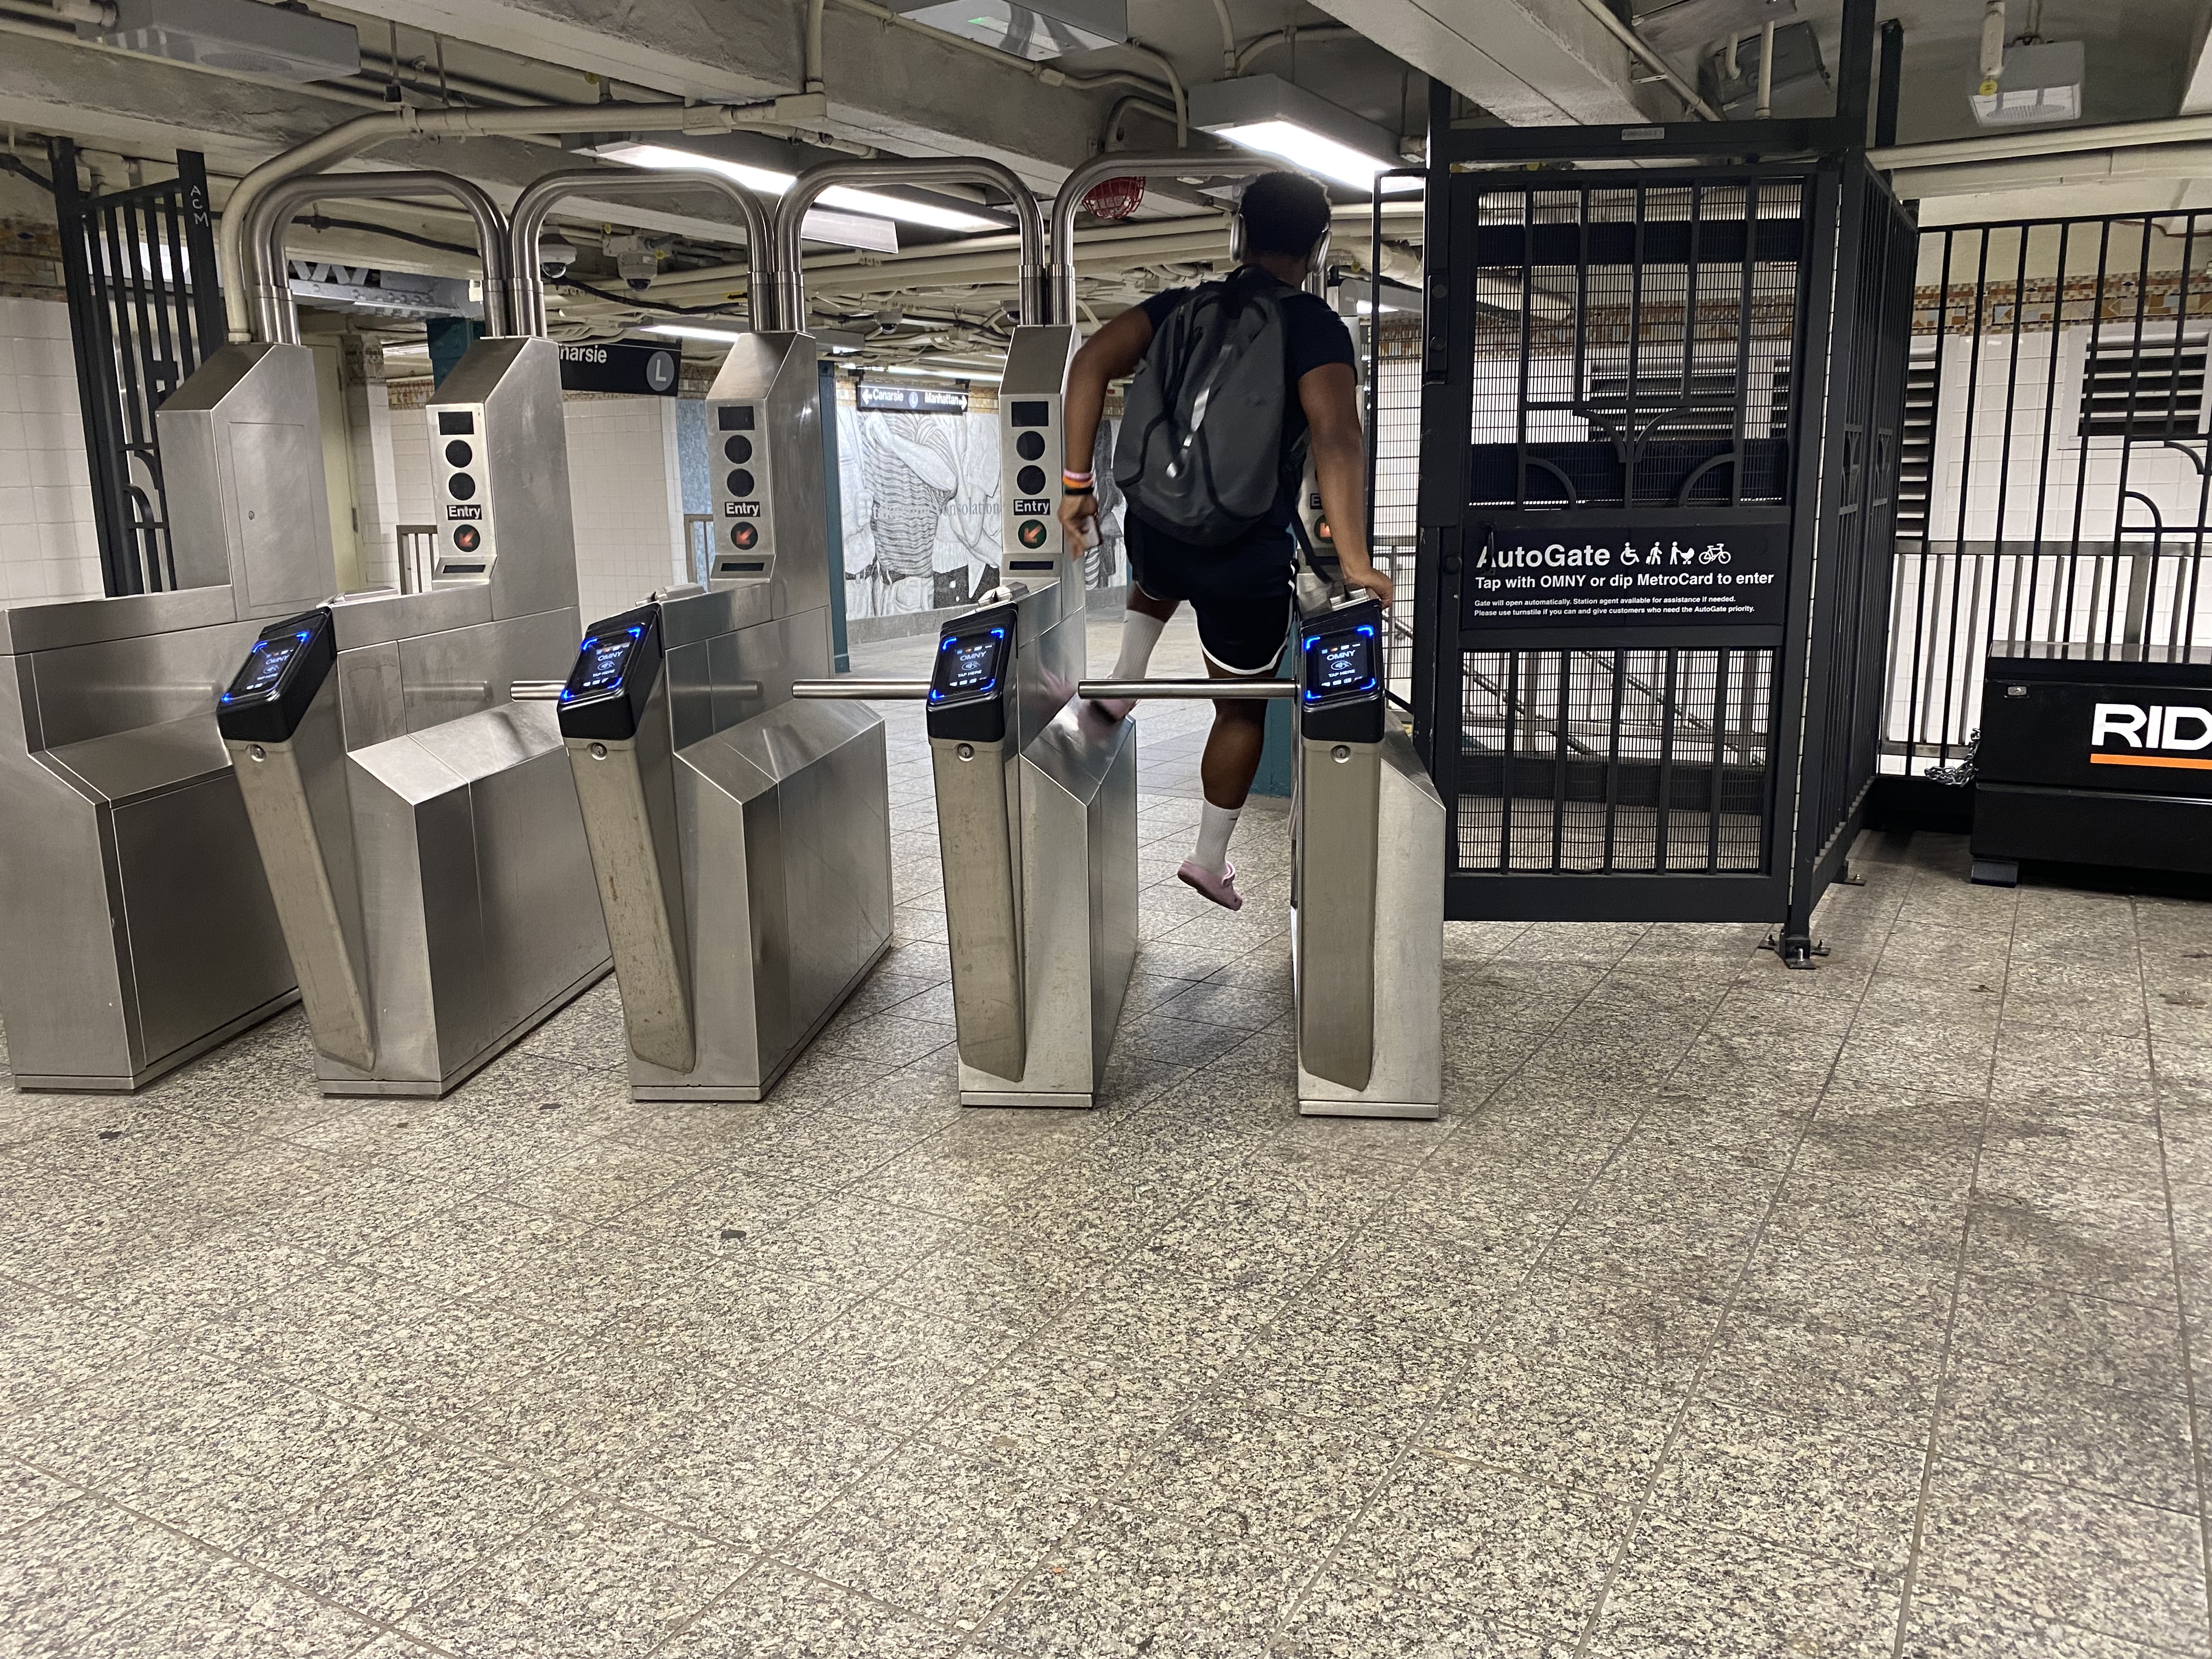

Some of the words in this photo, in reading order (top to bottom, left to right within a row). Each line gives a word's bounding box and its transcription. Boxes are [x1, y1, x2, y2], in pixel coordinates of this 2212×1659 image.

[190, 185, 208, 227] ACM
[656, 359, 667, 381] L
[872, 388, 904, 402] Canarsie
[924, 392, 959, 405] Manhattan
[449, 506, 481, 519] Entry
[726, 503, 759, 516] Entry
[1015, 500, 1049, 514] Entry
[1476, 544, 1610, 568] AutoGate
[1476, 577, 1500, 591] Tap
[1505, 576, 1535, 588] with
[1541, 575, 1586, 587] OMNY
[1590, 577, 1606, 586] or
[1610, 574, 1632, 589] dip
[1638, 573, 1713, 585] MetroCard
[1717, 573, 1731, 584] to
[1736, 573, 1774, 584] enter
[597, 651, 623, 661] OMNY
[960, 651, 986, 661] OMNY
[1327, 650, 1356, 661] OMNY
[2091, 703, 2212, 751] RID
